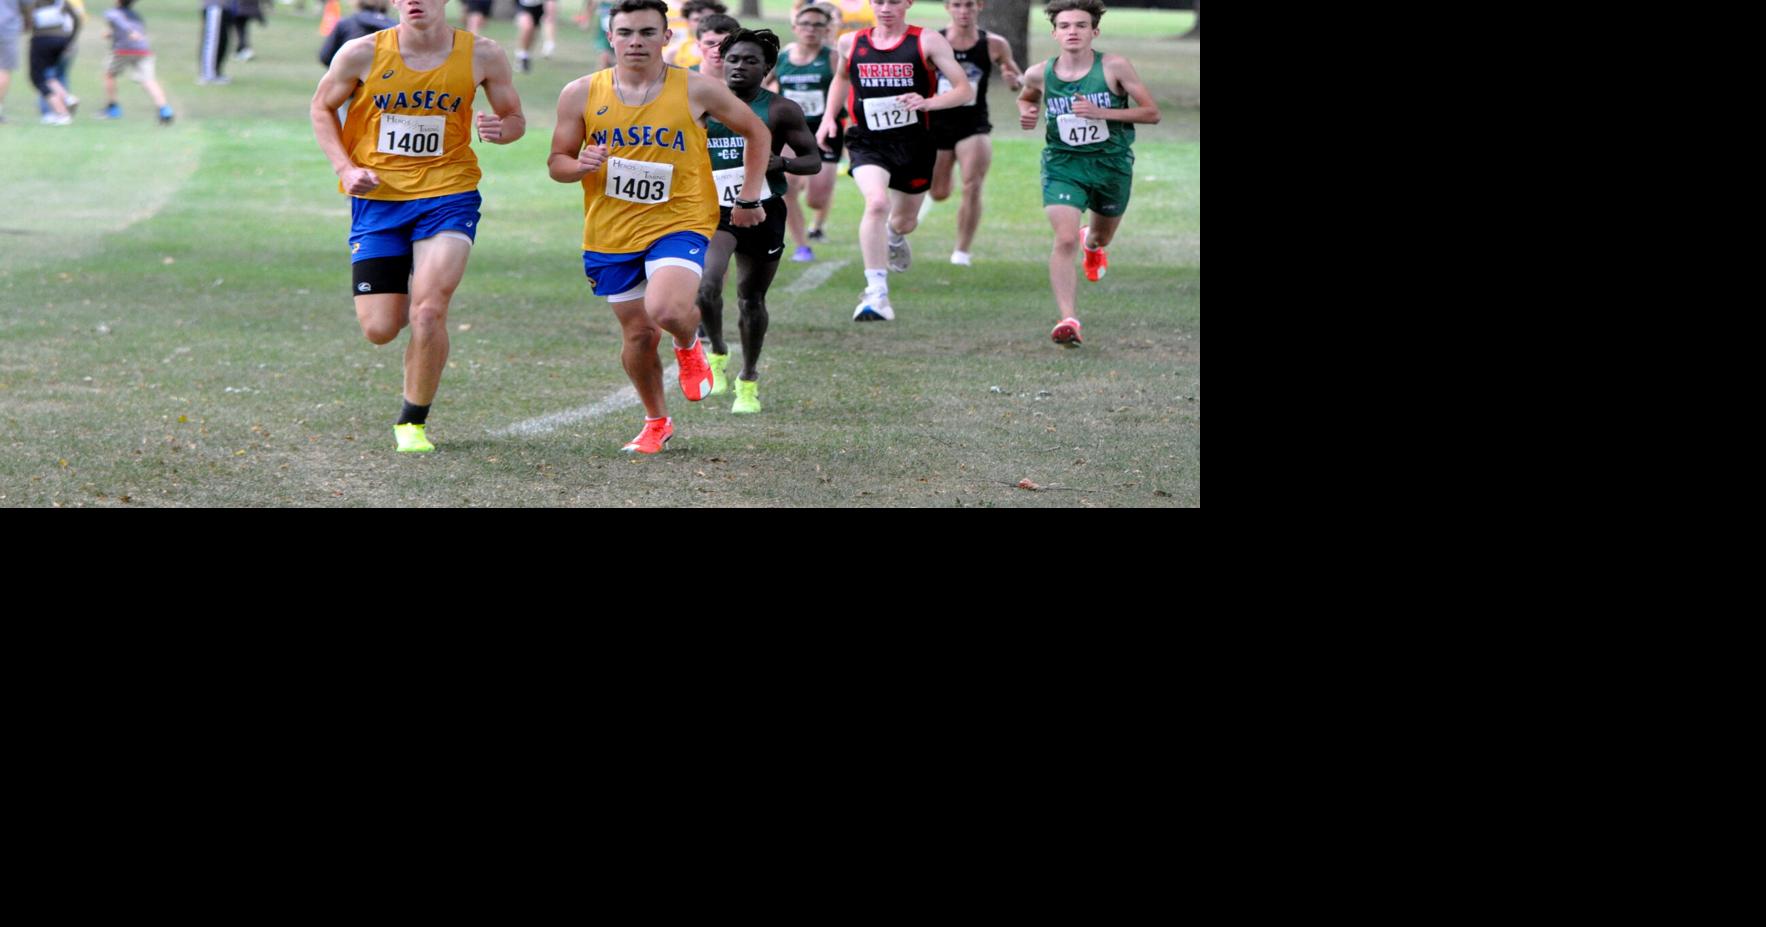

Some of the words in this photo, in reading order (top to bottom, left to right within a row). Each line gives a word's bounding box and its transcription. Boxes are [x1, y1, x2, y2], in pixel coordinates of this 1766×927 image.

[857, 63, 914, 78] NRHEG
[860, 78, 914, 87] PANTHERS
[373, 90, 462, 112] WASECA
[1084, 92, 1111, 109] IVER
[387, 131, 439, 153] 1400
[591, 126, 685, 151] WASECA
[1069, 126, 1100, 142] 472
[612, 176, 665, 200] 1403
